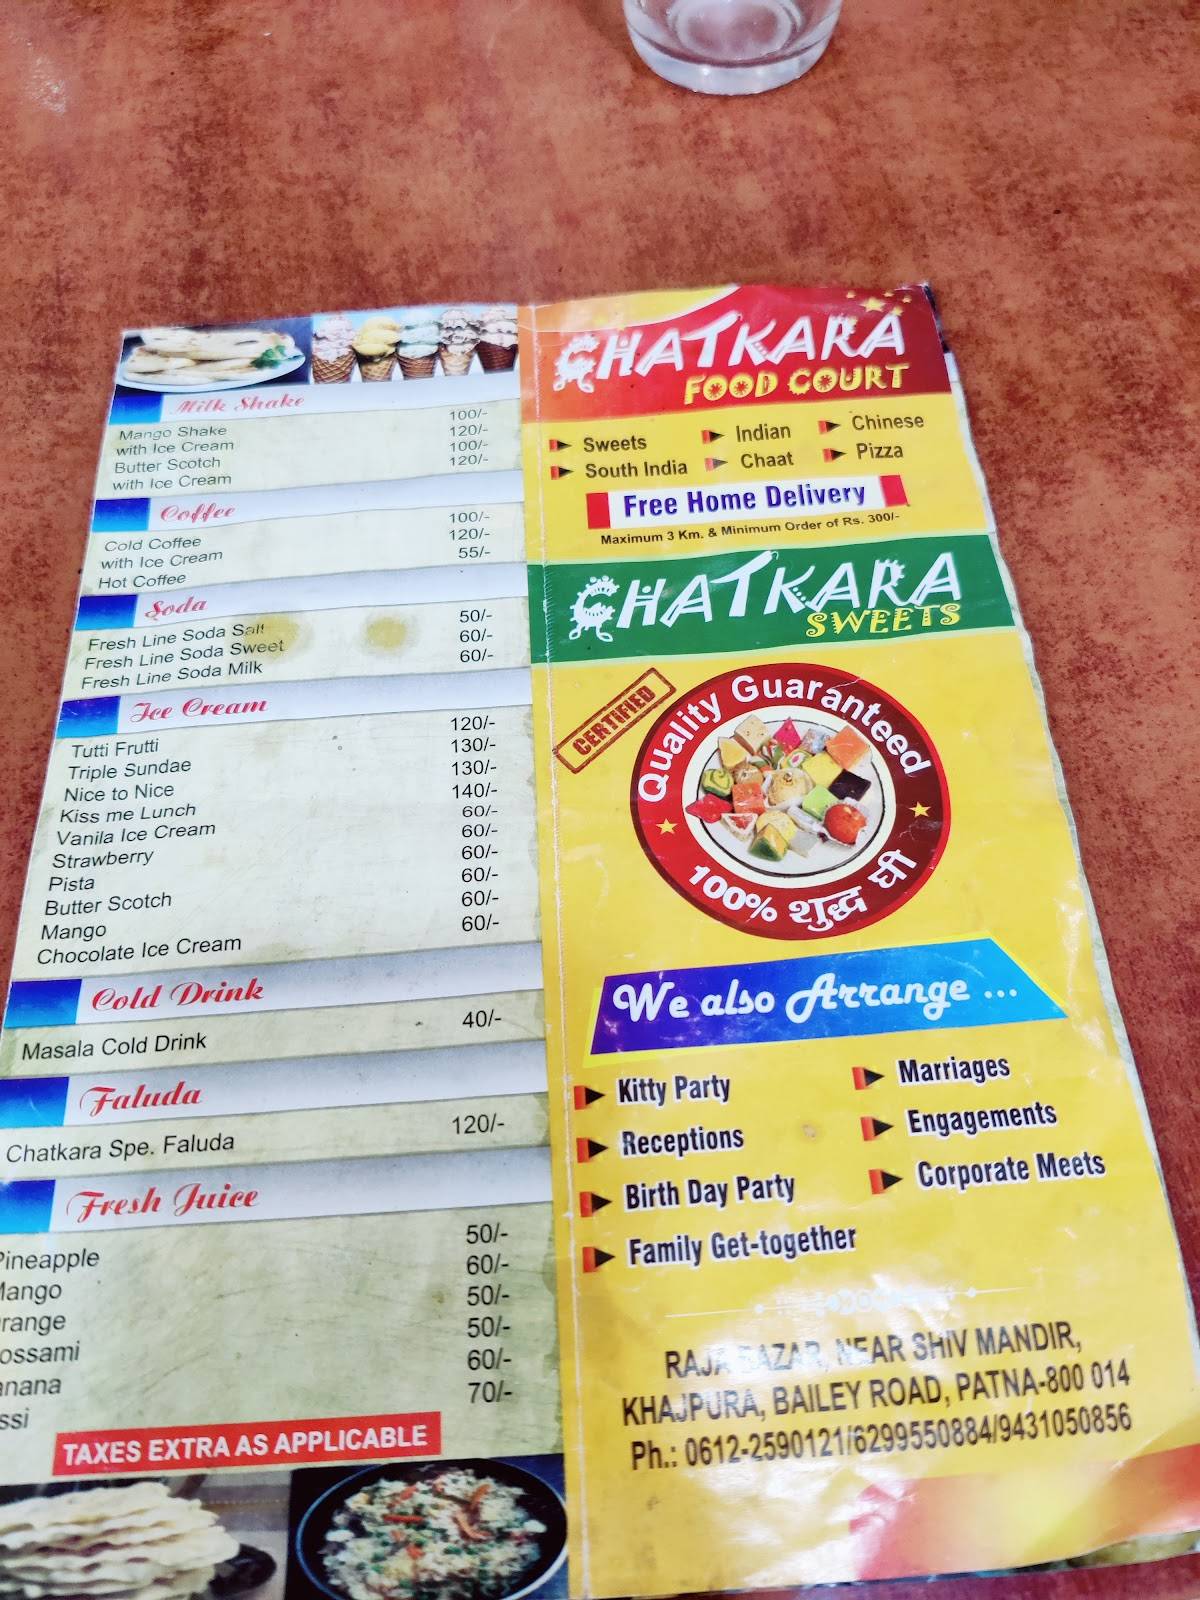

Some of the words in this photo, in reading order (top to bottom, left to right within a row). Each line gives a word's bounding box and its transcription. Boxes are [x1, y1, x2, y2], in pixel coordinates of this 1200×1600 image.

[553, 310, 905, 393] CHATKARA
[684, 371, 778, 405] FOOD
[787, 363, 909, 396] COURT
[172, 398, 225, 414] Milk
[234, 394, 305, 412] Shake
[449, 408, 488, 421] 100/-
[119, 430, 172, 442] Mango
[177, 426, 227, 438] Shake
[449, 424, 488, 437] 120/-
[735, 424, 792, 443] Indian
[851, 414, 925, 432] Chinese
[116, 444, 147, 456] with
[153, 443, 176, 454] Ice
[181, 441, 235, 453] Cream
[449, 439, 489, 452] 100/-
[583, 435, 648, 454] Sweets
[856, 443, 904, 460] Pizza
[114, 461, 162, 475] Butter
[167, 457, 221, 471] Scotch
[449, 454, 489, 467] 120/-
[585, 461, 640, 480] South
[644, 460, 688, 477] India
[740, 451, 794, 469] Chaat
[112, 480, 144, 491] with
[150, 478, 173, 489] Ice
[178, 475, 232, 488] Cream
[624, 493, 678, 519] Free
[687, 487, 757, 515] Home
[765, 481, 866, 510] Delivery
[160, 503, 236, 523] Coffee
[449, 511, 490, 524] 100/-
[449, 528, 491, 541] 120/-
[600, 531, 664, 546] Maximum
[666, 531, 675, 542] 3
[678, 528, 704, 541] Km.
[708, 527, 718, 539] &
[721, 521, 782, 538] Minimum
[785, 518, 822, 533] Order
[825, 516, 839, 529] of
[842, 514, 865, 527] Rs.
[868, 511, 900, 525] 300/-
[104, 540, 143, 552] Cold
[148, 537, 202, 550] Coffee
[458, 546, 491, 559] 55/-
[101, 557, 133, 570] with
[139, 557, 164, 568] Ice
[170, 551, 223, 567] Cream
[98, 577, 127, 589] Hot
[133, 573, 187, 588] Coffee
[568, 551, 961, 643] CHATKARA
[145, 596, 208, 621] Soda
[459, 609, 493, 623] 50/-
[805, 602, 962, 639] SWEETS
[88, 637, 137, 652] Fresh
[142, 633, 177, 648] Line
[182, 627, 226, 642] Soda
[459, 628, 493, 642] 60/-
[84, 656, 133, 670] Fresh
[139, 652, 174, 667] Line
[179, 646, 224, 660] Soda
[229, 639, 285, 655] Sweet
[460, 648, 494, 663] 60/-
[81, 675, 130, 689] Fresh
[136, 671, 171, 686] Line
[177, 665, 222, 680] Soda
[228, 661, 263, 676] Milk
[130, 702, 174, 722] Ice
[182, 697, 268, 717] Cream
[573, 684, 657, 757] CERTIFIED
[450, 715, 496, 731] 120/-
[71, 743, 109, 759] Tutti
[115, 738, 159, 757] Frutti
[451, 737, 496, 753] 130/-
[637, 690, 722, 804] Quality
[731, 674, 933, 775] Guaranteed
[67, 764, 118, 783] Triple
[124, 759, 192, 778] Sundae
[451, 759, 497, 776] 130/-
[64, 787, 105, 802] Nice
[112, 787, 129, 801] to
[134, 783, 175, 799] Nice
[452, 782, 498, 799] 140/-
[60, 809, 100, 823] Kiss
[106, 810, 135, 823] me
[140, 803, 196, 821] Lunch
[462, 804, 498, 818] 60/-
[57, 830, 114, 846] Vanila
[121, 828, 147, 843] Ice
[154, 823, 216, 839] Cream
[461, 823, 498, 838] 60/-
[52, 849, 154, 869] Strawberry
[461, 844, 499, 860] 60/-
[48, 876, 95, 892] Pista
[461, 866, 499, 882] 60/-
[461, 889, 499, 907] 60/-
[687, 864, 778, 923] 100%
[788, 886, 868, 932] शुद्ध
[867, 848, 918, 889] घी
[44, 899, 102, 916] Butter
[108, 892, 172, 912] Scotch
[41, 923, 107, 942] Mango
[461, 914, 500, 932] 60/-
[37, 944, 134, 965] Chocolate
[142, 942, 169, 958] Ice
[176, 937, 242, 955] Cream
[91, 984, 164, 1012] Cold
[170, 977, 265, 1007] Drink
[612, 980, 690, 1023] We
[700, 978, 776, 1019] also
[785, 972, 971, 1024] Arrange
[462, 1009, 502, 1028] 40/-
[22, 1040, 94, 1060] Masala
[101, 1036, 148, 1056] Cold
[154, 1032, 207, 1052] Drink
[898, 1054, 1011, 1087] Marriages
[79, 1081, 203, 1118] Faluda
[618, 1077, 668, 1107] Kitty
[674, 1073, 731, 1104] Party
[452, 1112, 505, 1135] 120/-
[907, 1101, 1058, 1139] Engagements
[6, 1142, 102, 1163] Chatkara
[109, 1138, 155, 1162] Spe.
[163, 1132, 235, 1155] Faluda
[622, 1127, 744, 1160] Receptions
[917, 1155, 1029, 1194] Corporate
[1036, 1151, 1107, 1181] Meets
[66, 1186, 162, 1224] Fresh
[173, 1182, 259, 1217] Juice
[625, 1181, 680, 1211] Birth
[687, 1178, 729, 1211] Day
[736, 1173, 796, 1204] Party
[466, 1222, 508, 1245] 50/-
[629, 1234, 702, 1268] Family
[710, 1225, 858, 1263] Get-together
[466, 1253, 509, 1276] 60/-
[466, 1284, 510, 1307] 50/-
[467, 1315, 510, 1339] 50/-
[911, 1329, 967, 1361] SHIV
[976, 1321, 1082, 1356] MANDIR,
[467, 1347, 511, 1371] 60/-
[467, 1380, 513, 1404] 70/-
[622, 1387, 767, 1428] KHAJPURA,
[773, 1380, 861, 1416] BAILEY
[871, 1374, 951, 1410] ROAD,
[956, 1361, 1084, 1402] PATNA-800
[1090, 1358, 1131, 1388] 014
[63, 1440, 141, 1466] TAXES
[147, 1436, 230, 1461] EXTRA
[235, 1433, 269, 1456] AS
[274, 1424, 428, 1455] APPLICABLE
[631, 1440, 678, 1471] Ph.:
[685, 1402, 1133, 1467] 0612-2590121/6299550884/9431050856
